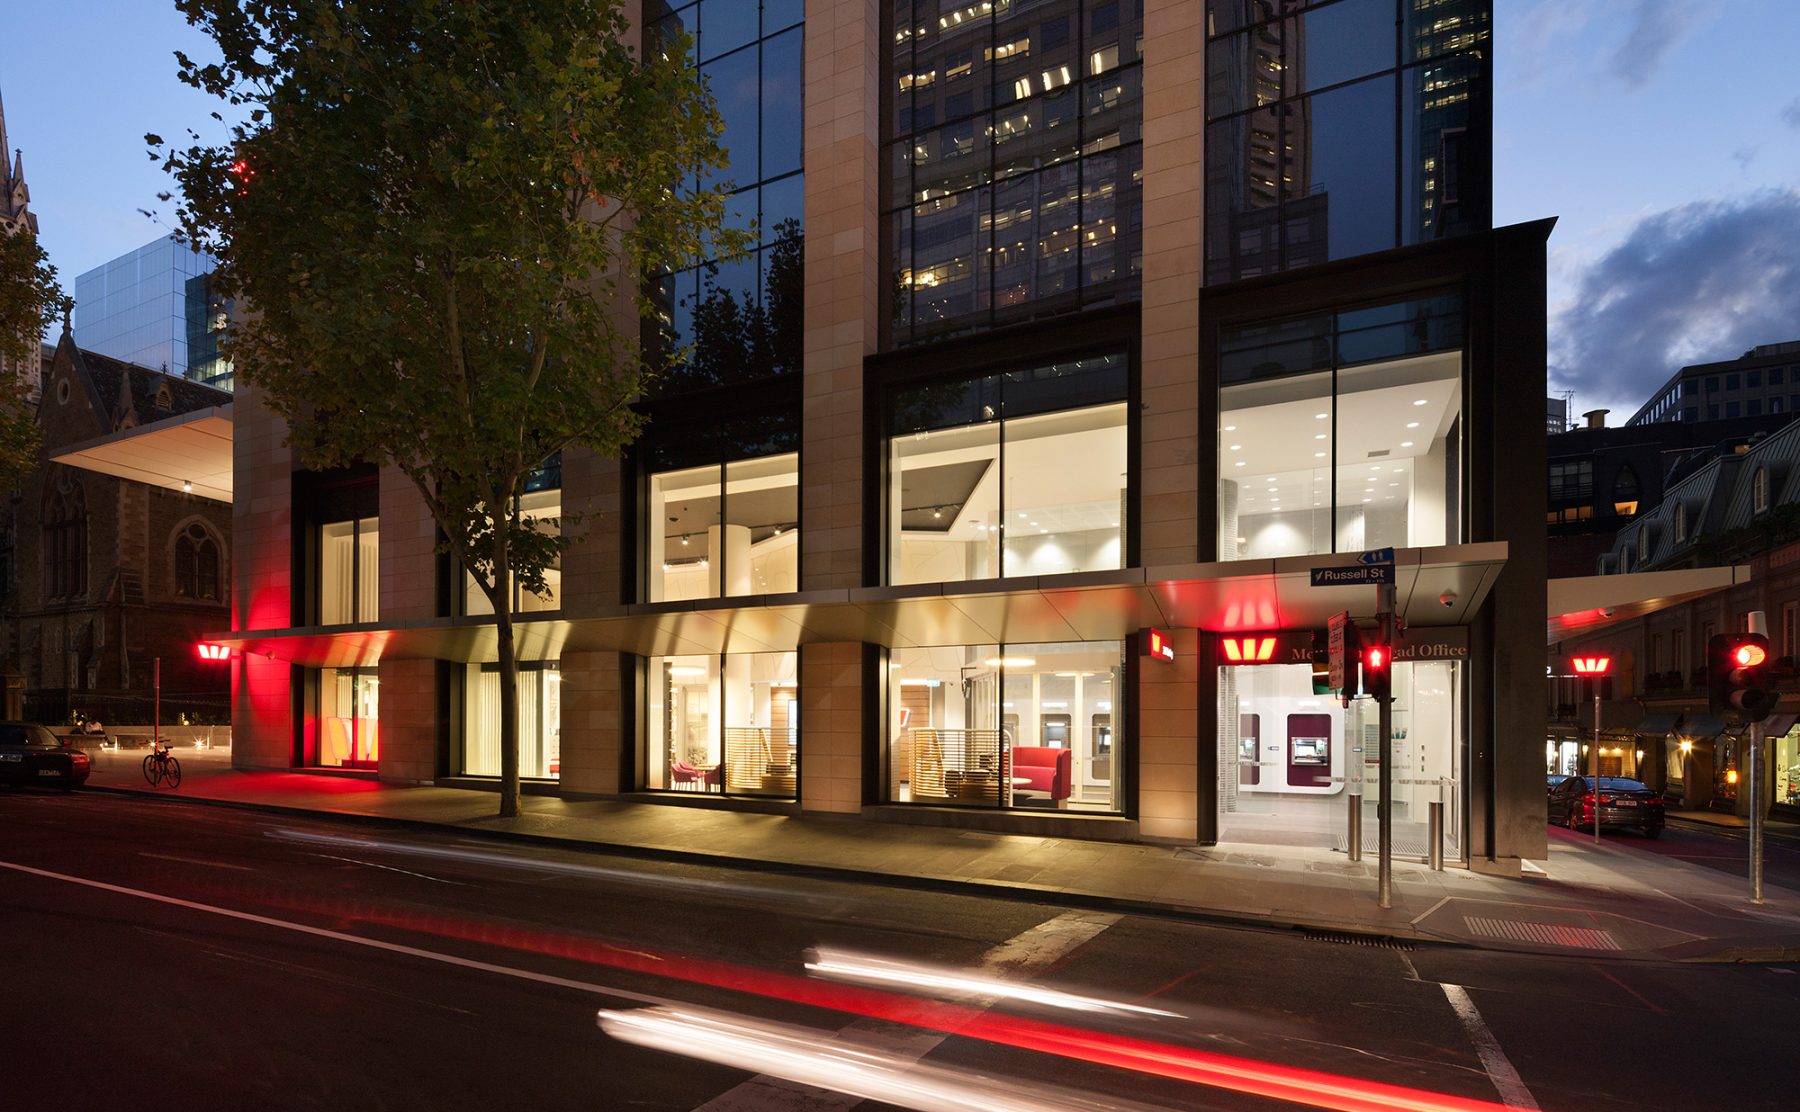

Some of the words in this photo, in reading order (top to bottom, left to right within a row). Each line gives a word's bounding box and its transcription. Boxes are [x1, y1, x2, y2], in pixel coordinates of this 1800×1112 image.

[1324, 569, 1367, 580] Russell
[1370, 568, 1384, 578] St
[1419, 644, 1467, 657] Office
